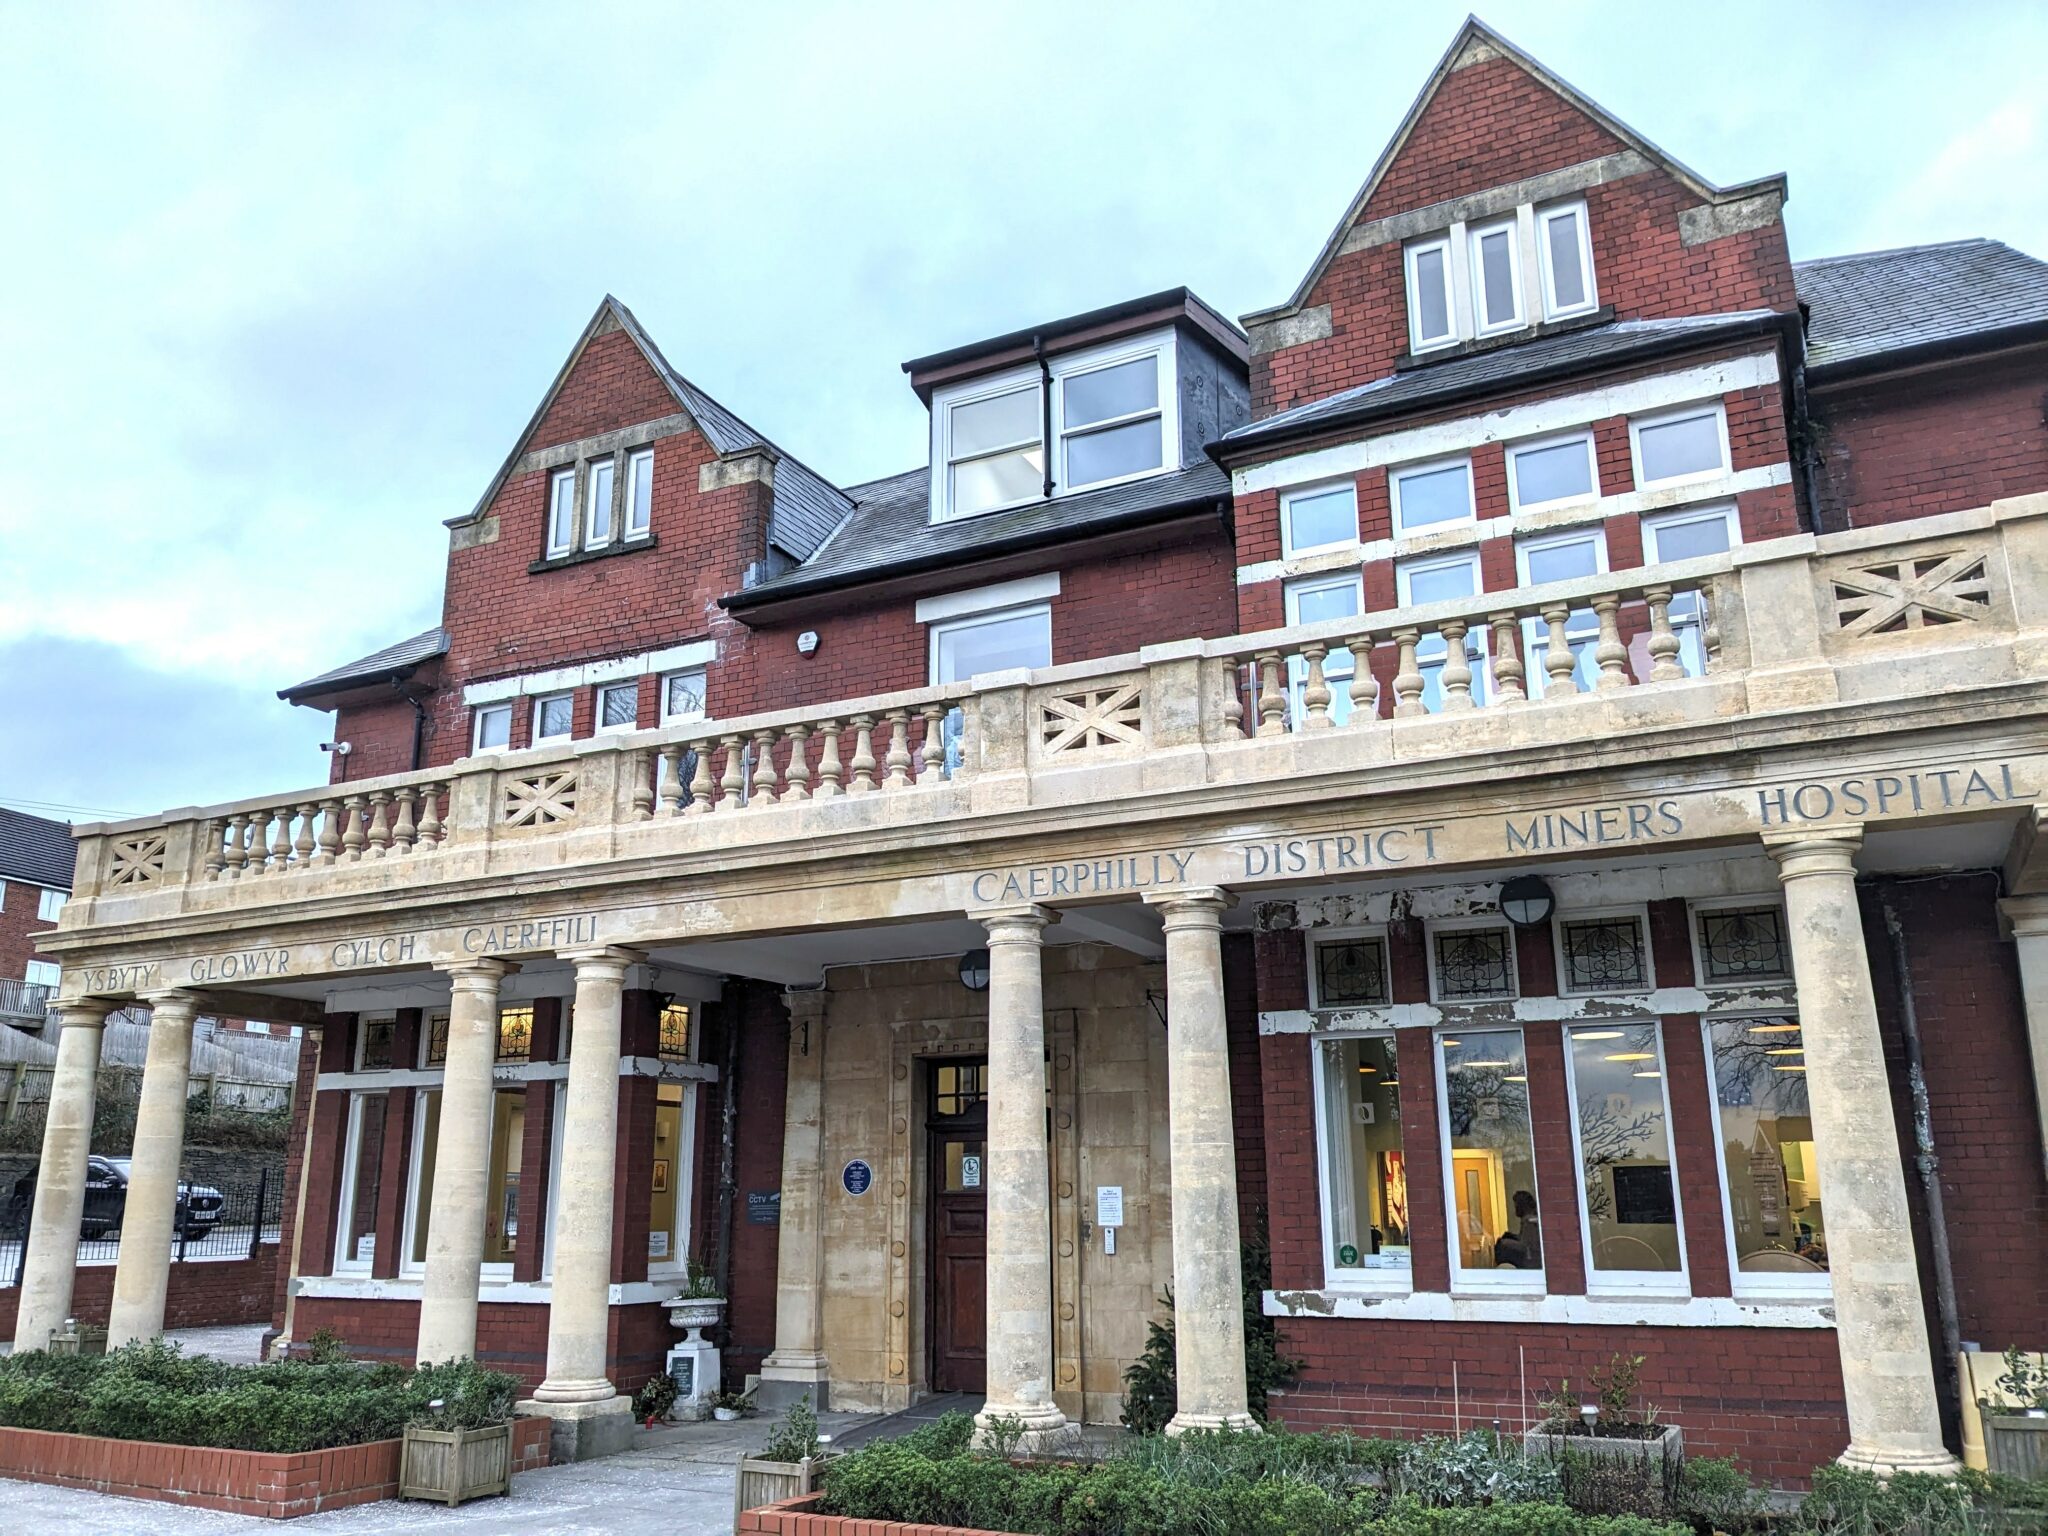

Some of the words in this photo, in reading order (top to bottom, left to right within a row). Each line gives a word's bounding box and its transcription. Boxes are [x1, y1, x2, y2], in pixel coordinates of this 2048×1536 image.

[972, 851, 1195, 902] CAERPHILLY
[1243, 826, 1445, 879] DISTRICT
[1505, 801, 1683, 853] MINERS
[1757, 764, 2042, 825] HOSPITAL
[84, 964, 154, 992] YSBYTY
[190, 950, 289, 982] GLOWYR
[331, 935, 415, 967] CYLCH
[462, 915, 597, 953] CAERFFILI
